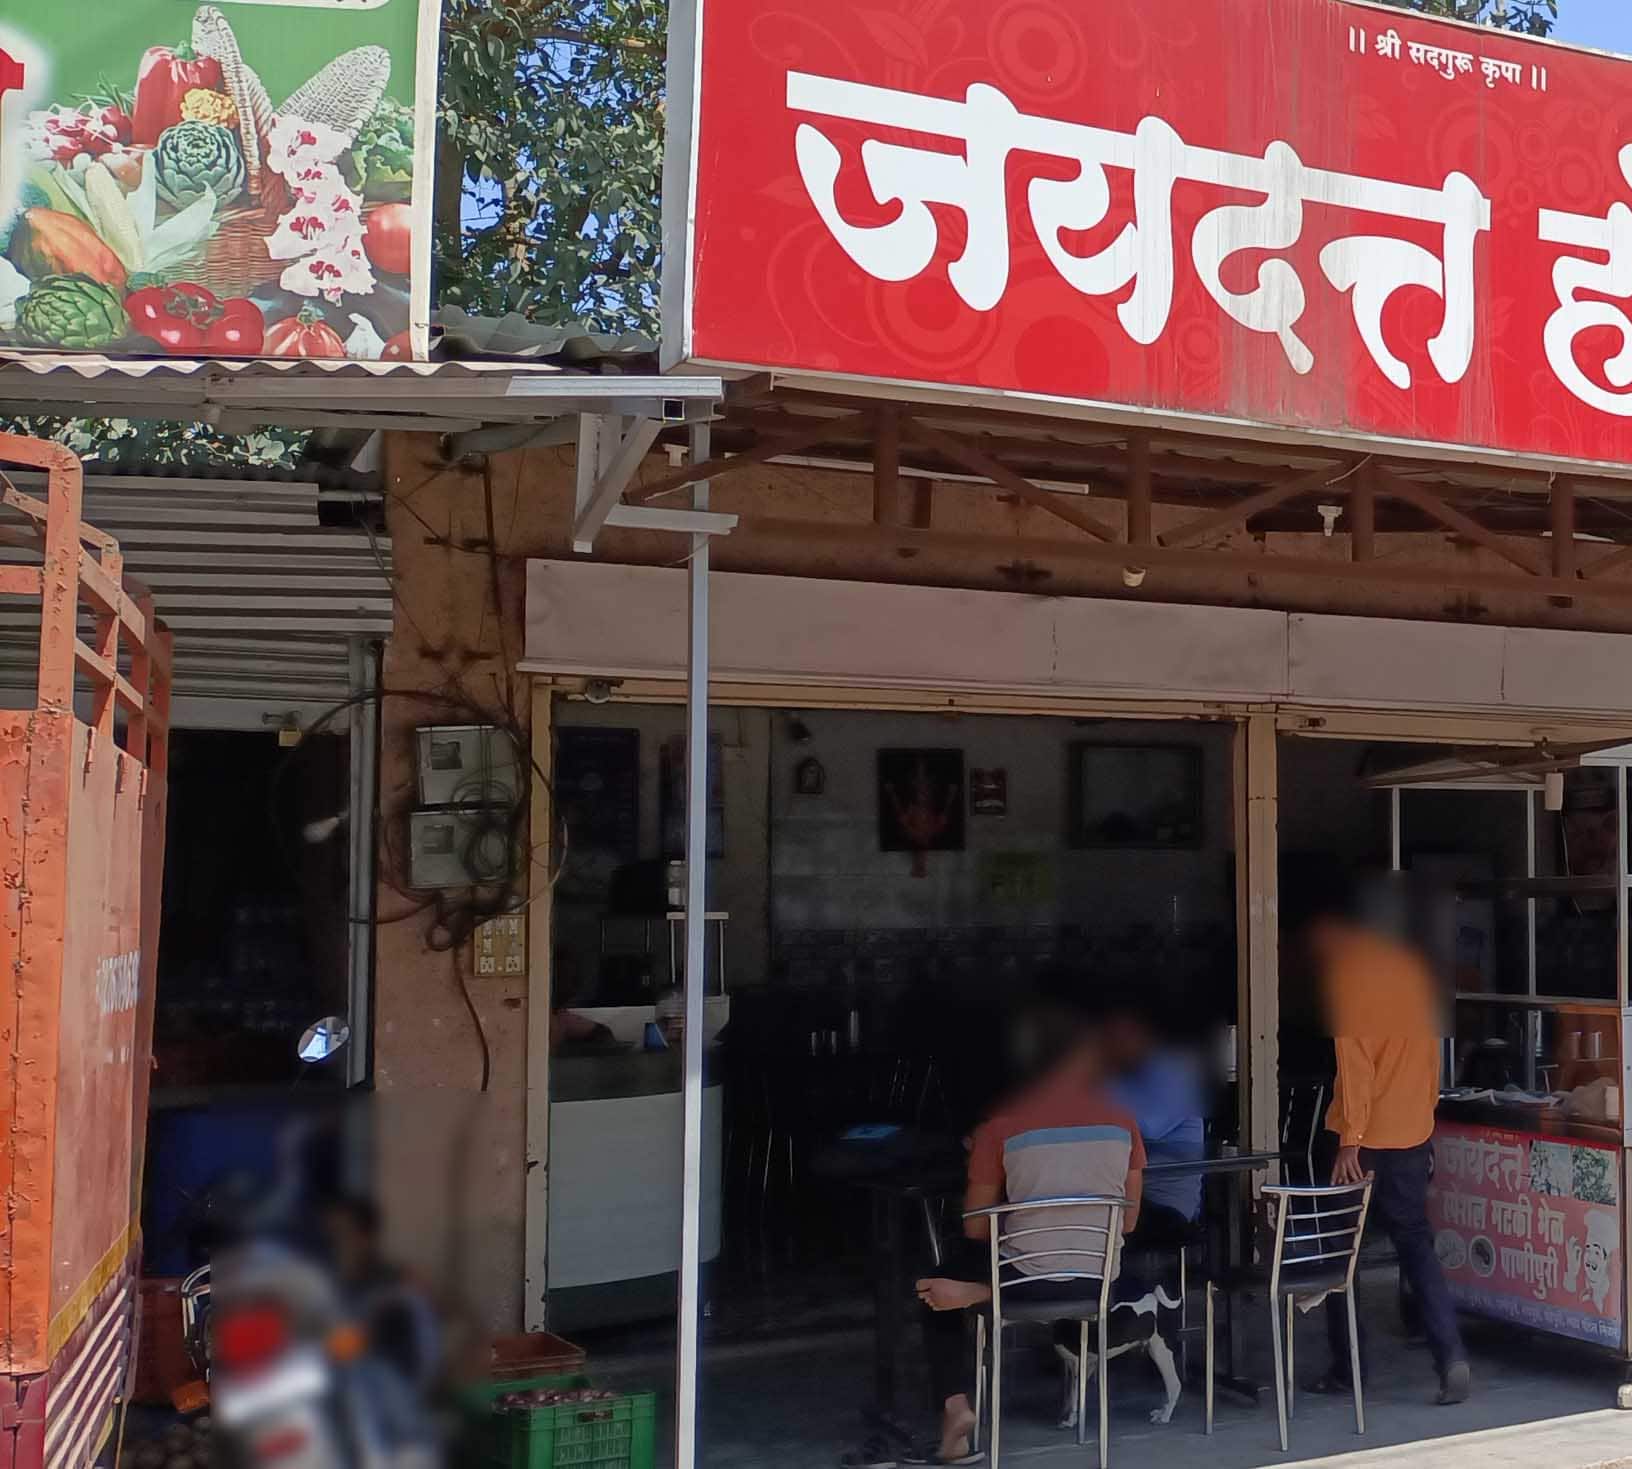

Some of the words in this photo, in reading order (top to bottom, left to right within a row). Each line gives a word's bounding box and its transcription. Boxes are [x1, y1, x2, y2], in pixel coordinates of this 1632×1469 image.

[1375, 29, 1401, 59] श्री
[1480, 56, 1522, 88] कृपा
[786, 70, 1490, 389] जयदत्त
[1501, 1242, 1559, 1300] पाणीपुरी
